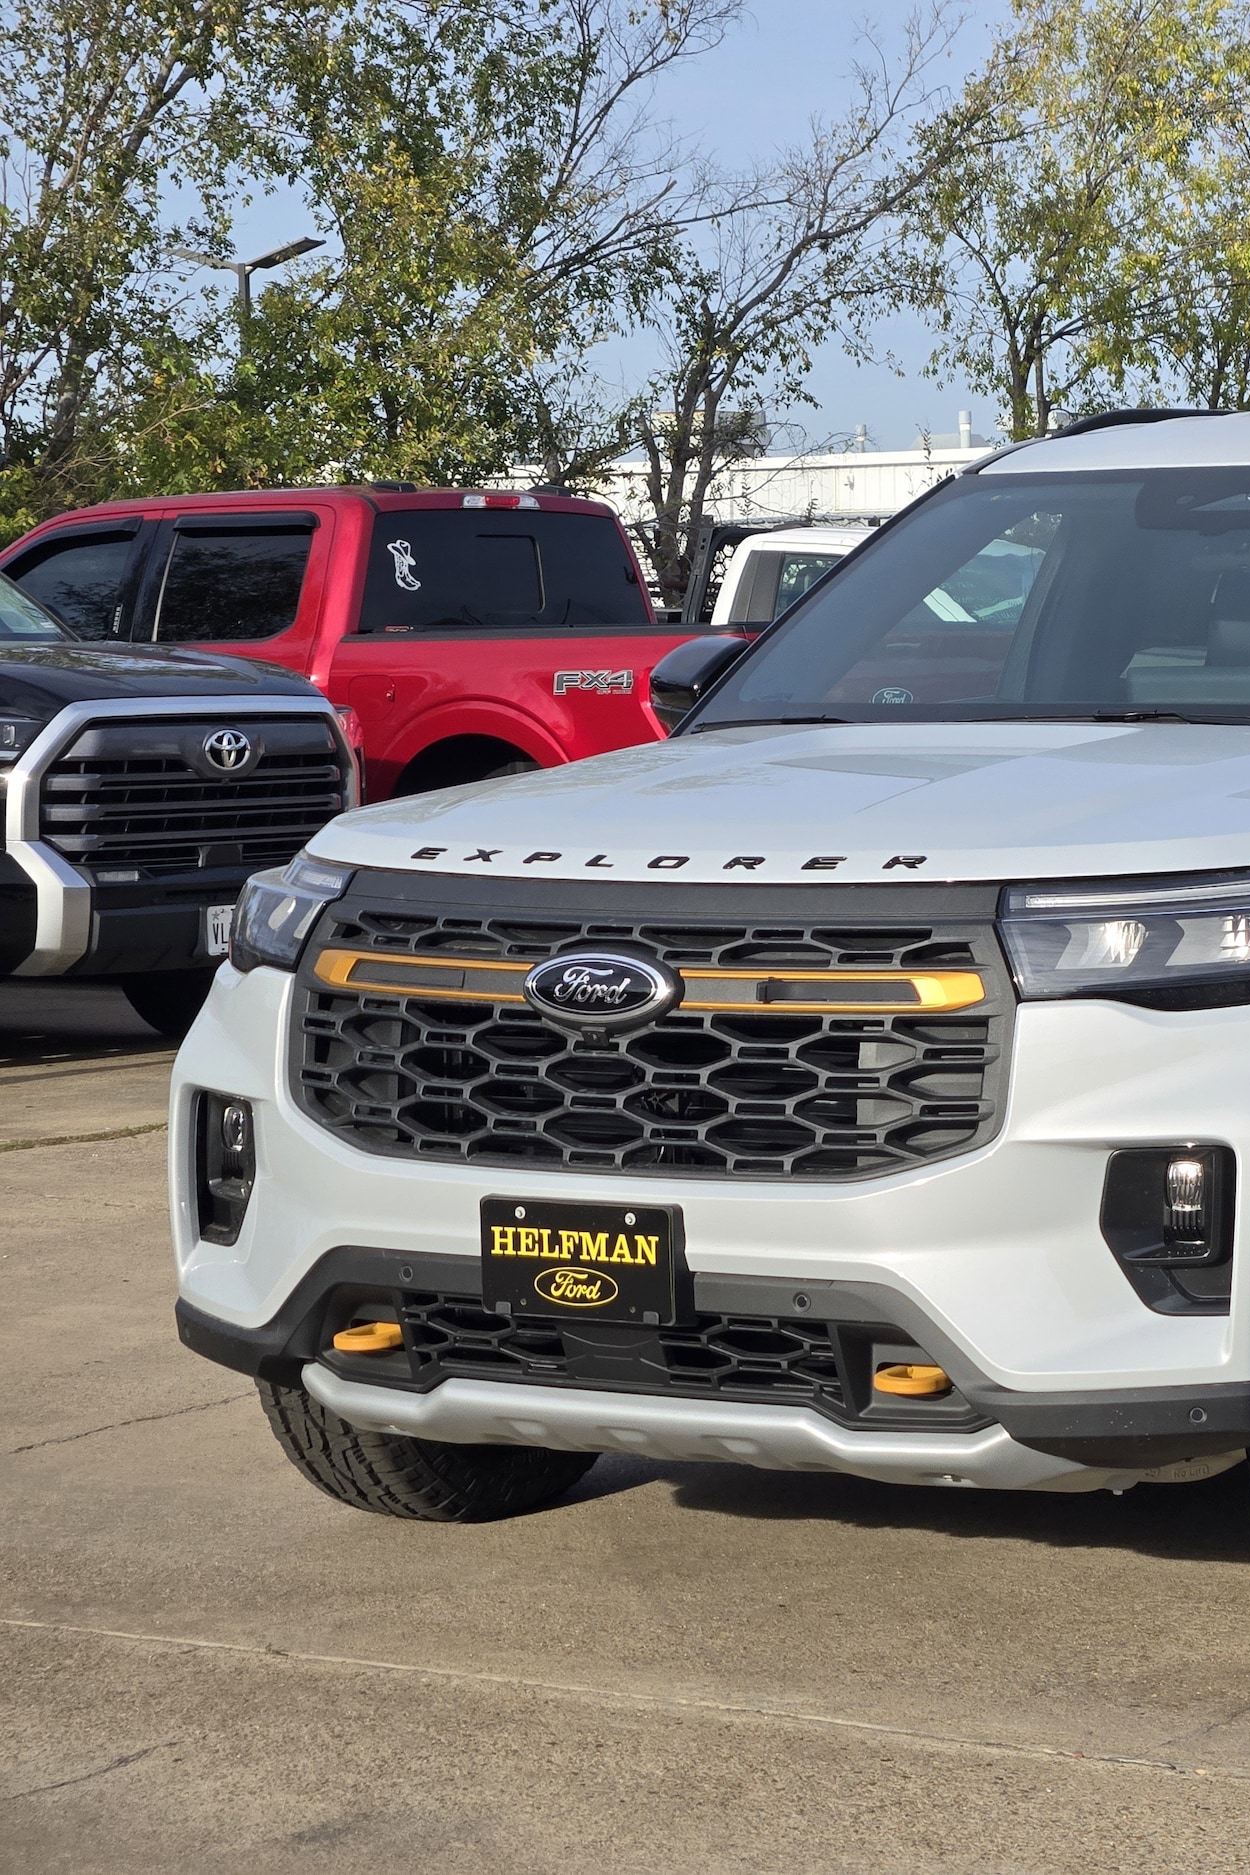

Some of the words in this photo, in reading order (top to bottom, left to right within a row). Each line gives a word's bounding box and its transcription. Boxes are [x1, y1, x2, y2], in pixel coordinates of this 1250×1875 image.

[553, 669, 634, 695] FX4
[409, 846, 929, 871] EXPLORER
[212, 922, 229, 944] VL
[553, 966, 632, 1005] Ford
[490, 1226, 660, 1265] HELFMAN
[550, 1270, 602, 1300] Ford
